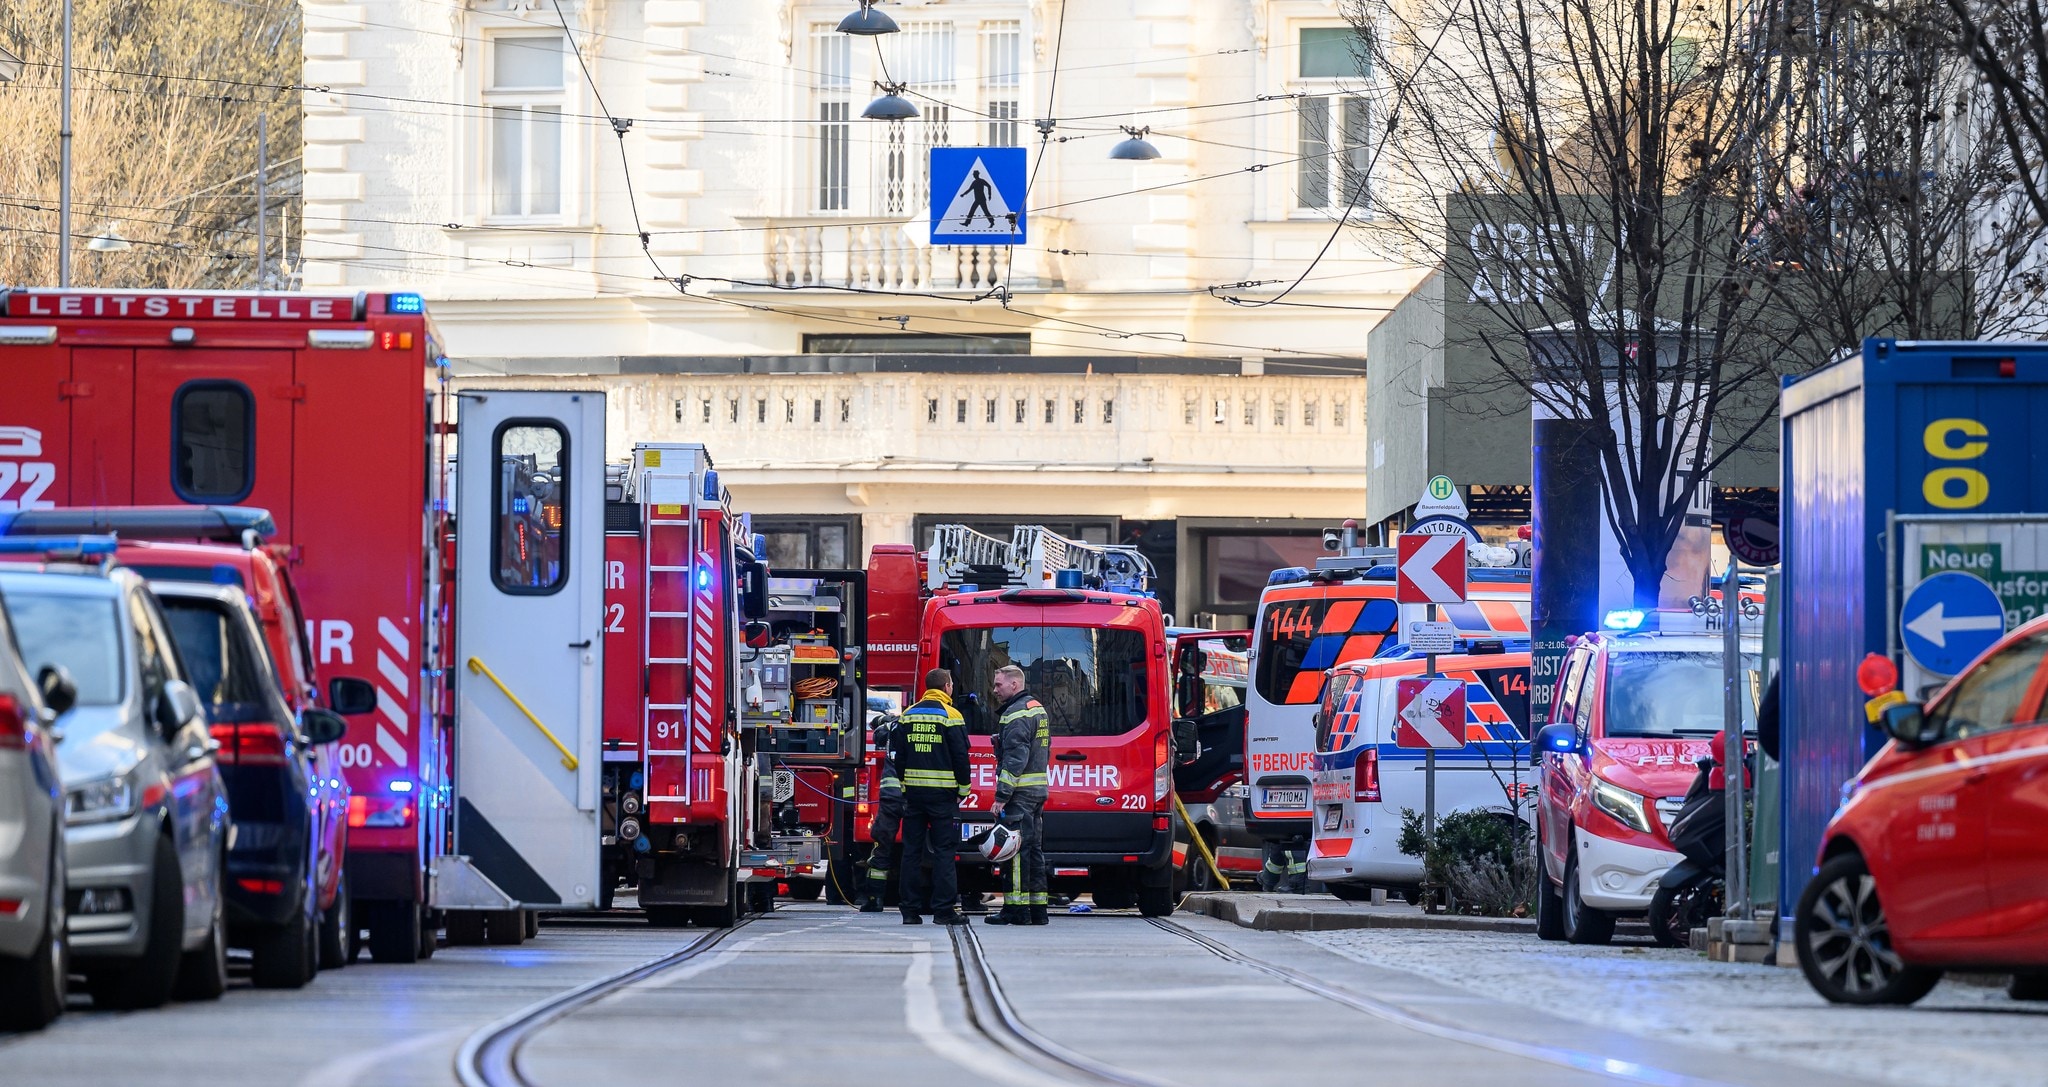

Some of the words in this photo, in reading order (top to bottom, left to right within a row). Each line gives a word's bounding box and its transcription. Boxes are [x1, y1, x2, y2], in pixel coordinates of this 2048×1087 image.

[29, 296, 334, 320] LEITSTELLE
[1435, 481, 1447, 495] H
[1417, 522, 1467, 535] UTOBU
[1928, 549, 1993, 569] Neue
[1270, 605, 1313, 641] 144
[866, 643, 918, 652] MAGIRUS
[1532, 656, 1567, 677] GUST
[1498, 674, 1531, 696] 14
[657, 721, 679, 739] 91
[912, 723, 936, 733] BERUFS
[914, 743, 932, 753] WIEN
[1263, 752, 1314, 772] BERUFS
[1121, 794, 1147, 810] 220
